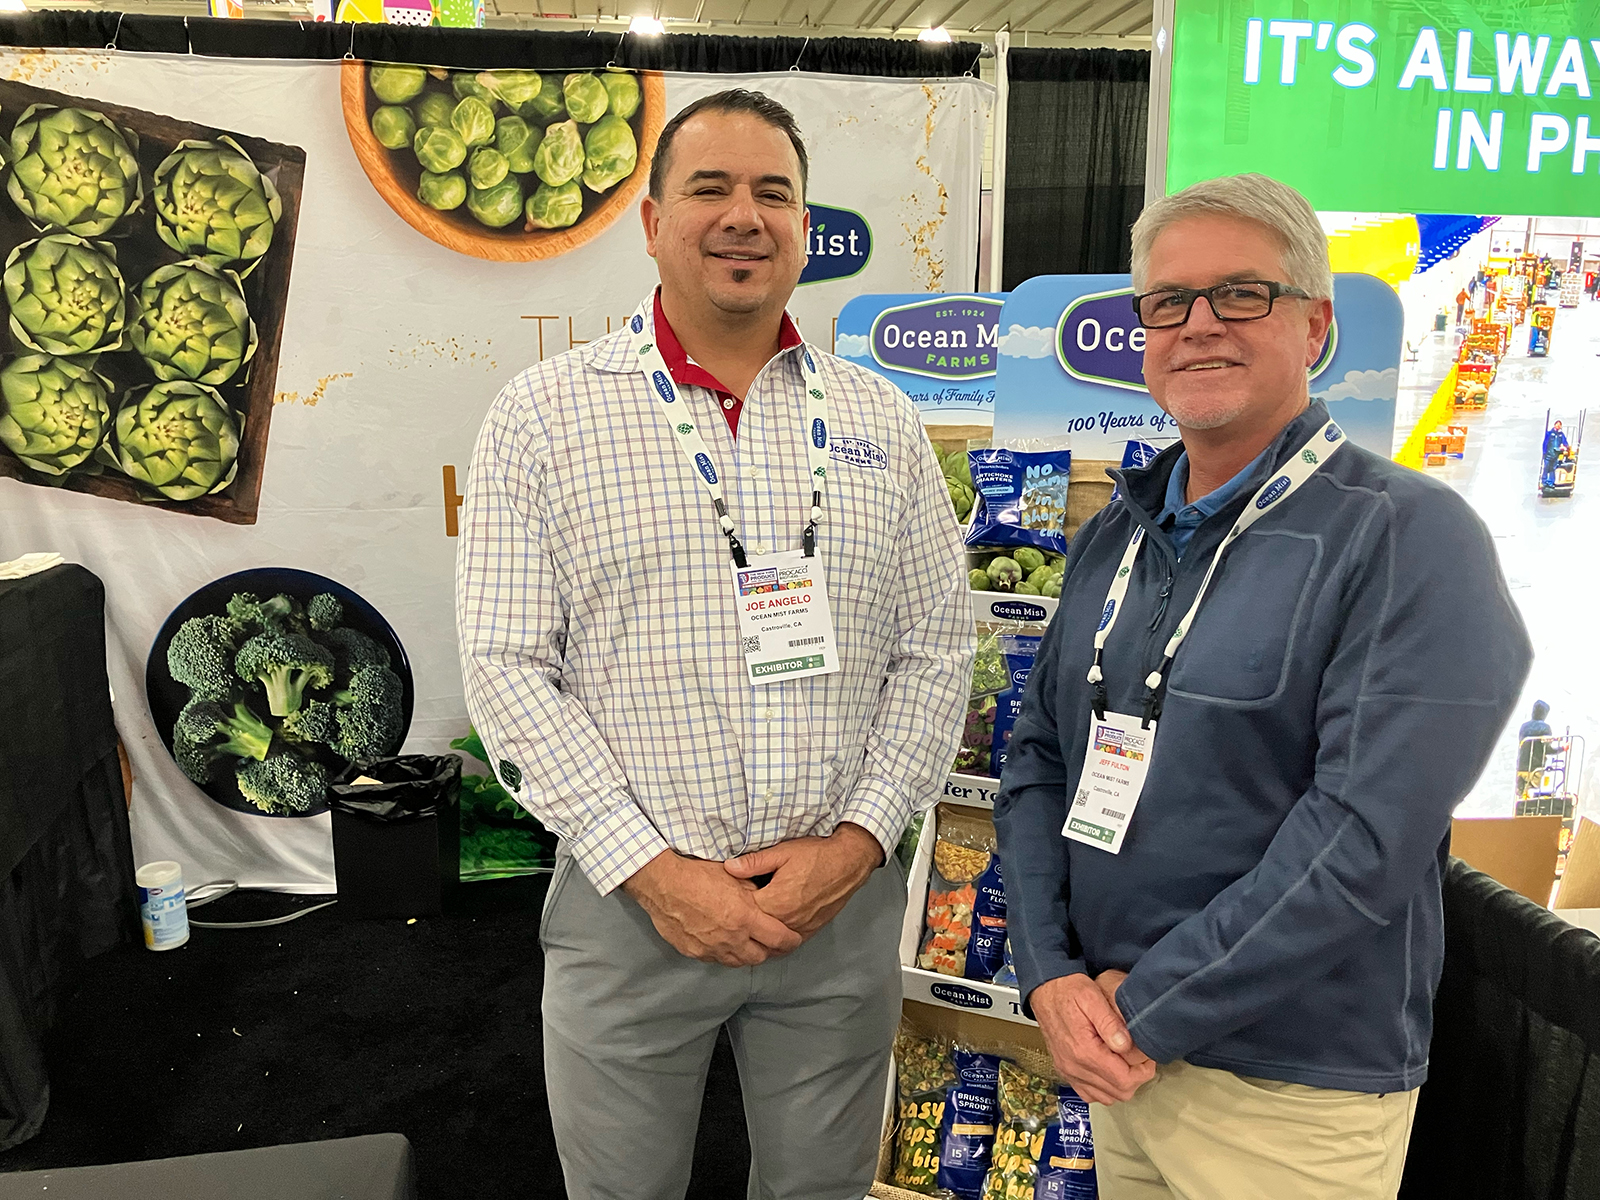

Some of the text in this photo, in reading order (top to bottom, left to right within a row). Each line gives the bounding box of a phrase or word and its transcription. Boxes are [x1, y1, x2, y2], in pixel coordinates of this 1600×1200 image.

[1244, 18, 1600, 98] IT'S ALWA
[1433, 108, 1504, 171] IN
[935, 309, 985, 318] EST. 1924
[883, 324, 968, 348] Ocean
[1075, 318, 1146, 352] Oce
[926, 353, 990, 367] FARMS
[932, 388, 945, 405] of
[945, 388, 984, 406] Family
[1067, 411, 1167, 434] 100 Years of
[862, 448, 884, 463] Mist
[1257, 477, 1290, 507] Ocean Mist
[1024, 509, 1063, 526] shor
[745, 594, 811, 612] JOE ANGELO
[993, 605, 1045, 617] Ocean Mist
[751, 613, 772, 621] OCEAN
[788, 608, 809, 616] FARMS
[755, 660, 803, 674] EXHIBITOR
[1015, 672, 1028, 680] Oce
[1111, 761, 1130, 771] FULTON
[1091, 771, 1105, 779] OCEAN
[934, 986, 965, 1000] Ocean
[967, 993, 990, 1005] Mist
[963, 1071, 984, 1079] Ocean
[957, 1092, 996, 1105] BRUSSELS
[912, 1147, 940, 1175] big
